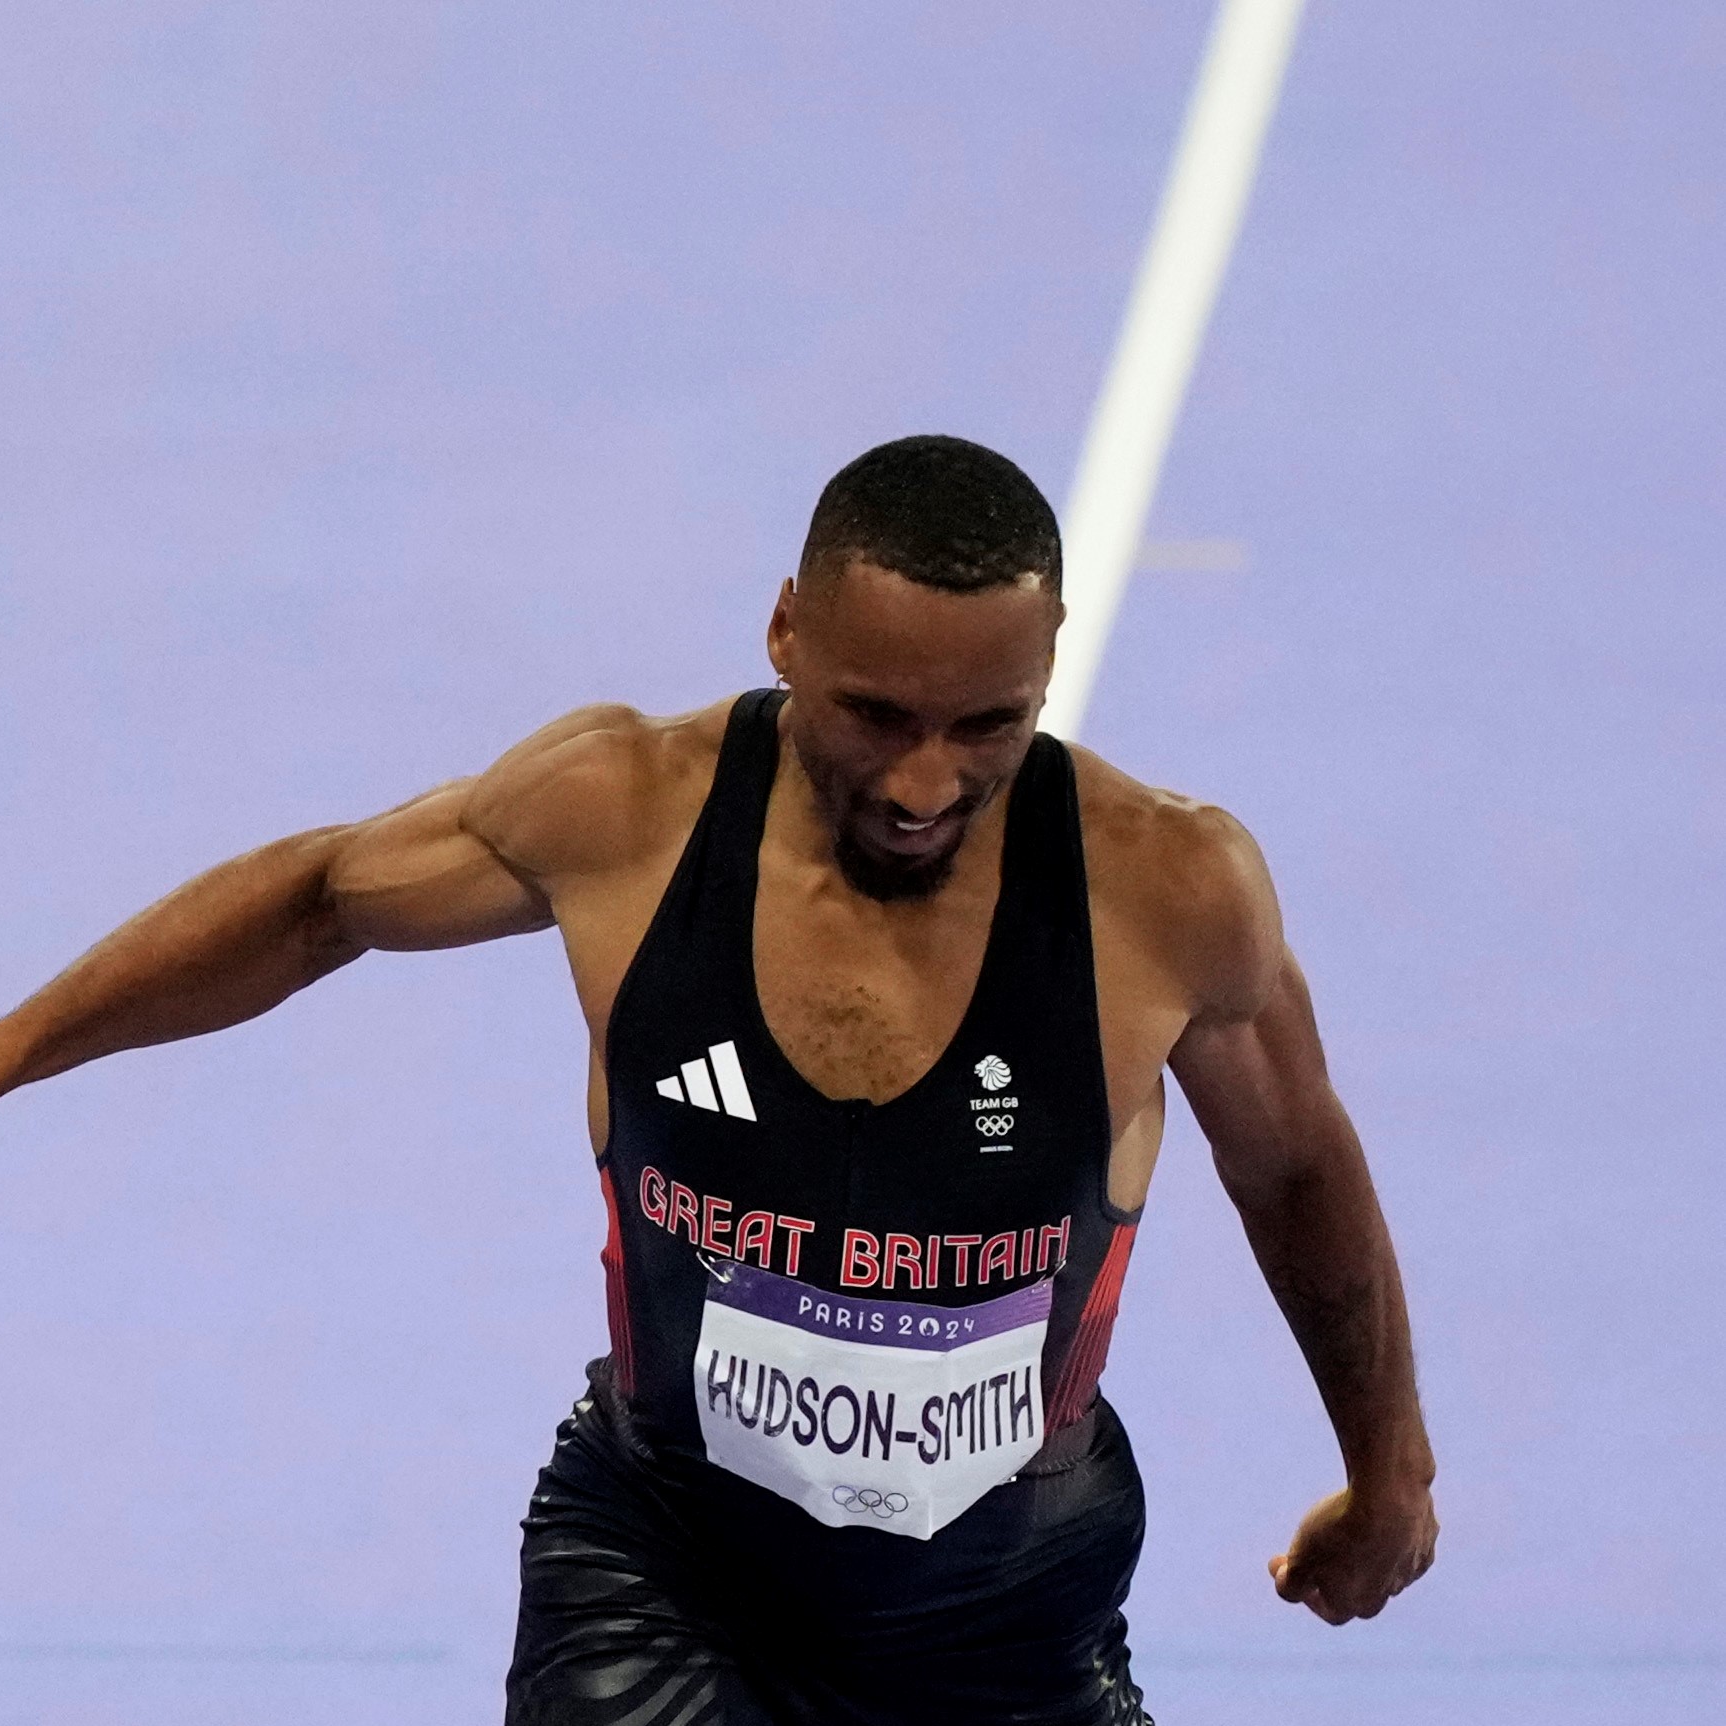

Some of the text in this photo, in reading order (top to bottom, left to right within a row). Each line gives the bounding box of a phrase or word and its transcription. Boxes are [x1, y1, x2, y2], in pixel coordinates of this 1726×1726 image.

[970, 1097, 1019, 1110] TEAM GB
[639, 1165, 1071, 1289] GREAT BRITAIN
[798, 1295, 975, 1340] PARIS 2024
[708, 1349, 1035, 1465] HUDSON-SMITH
